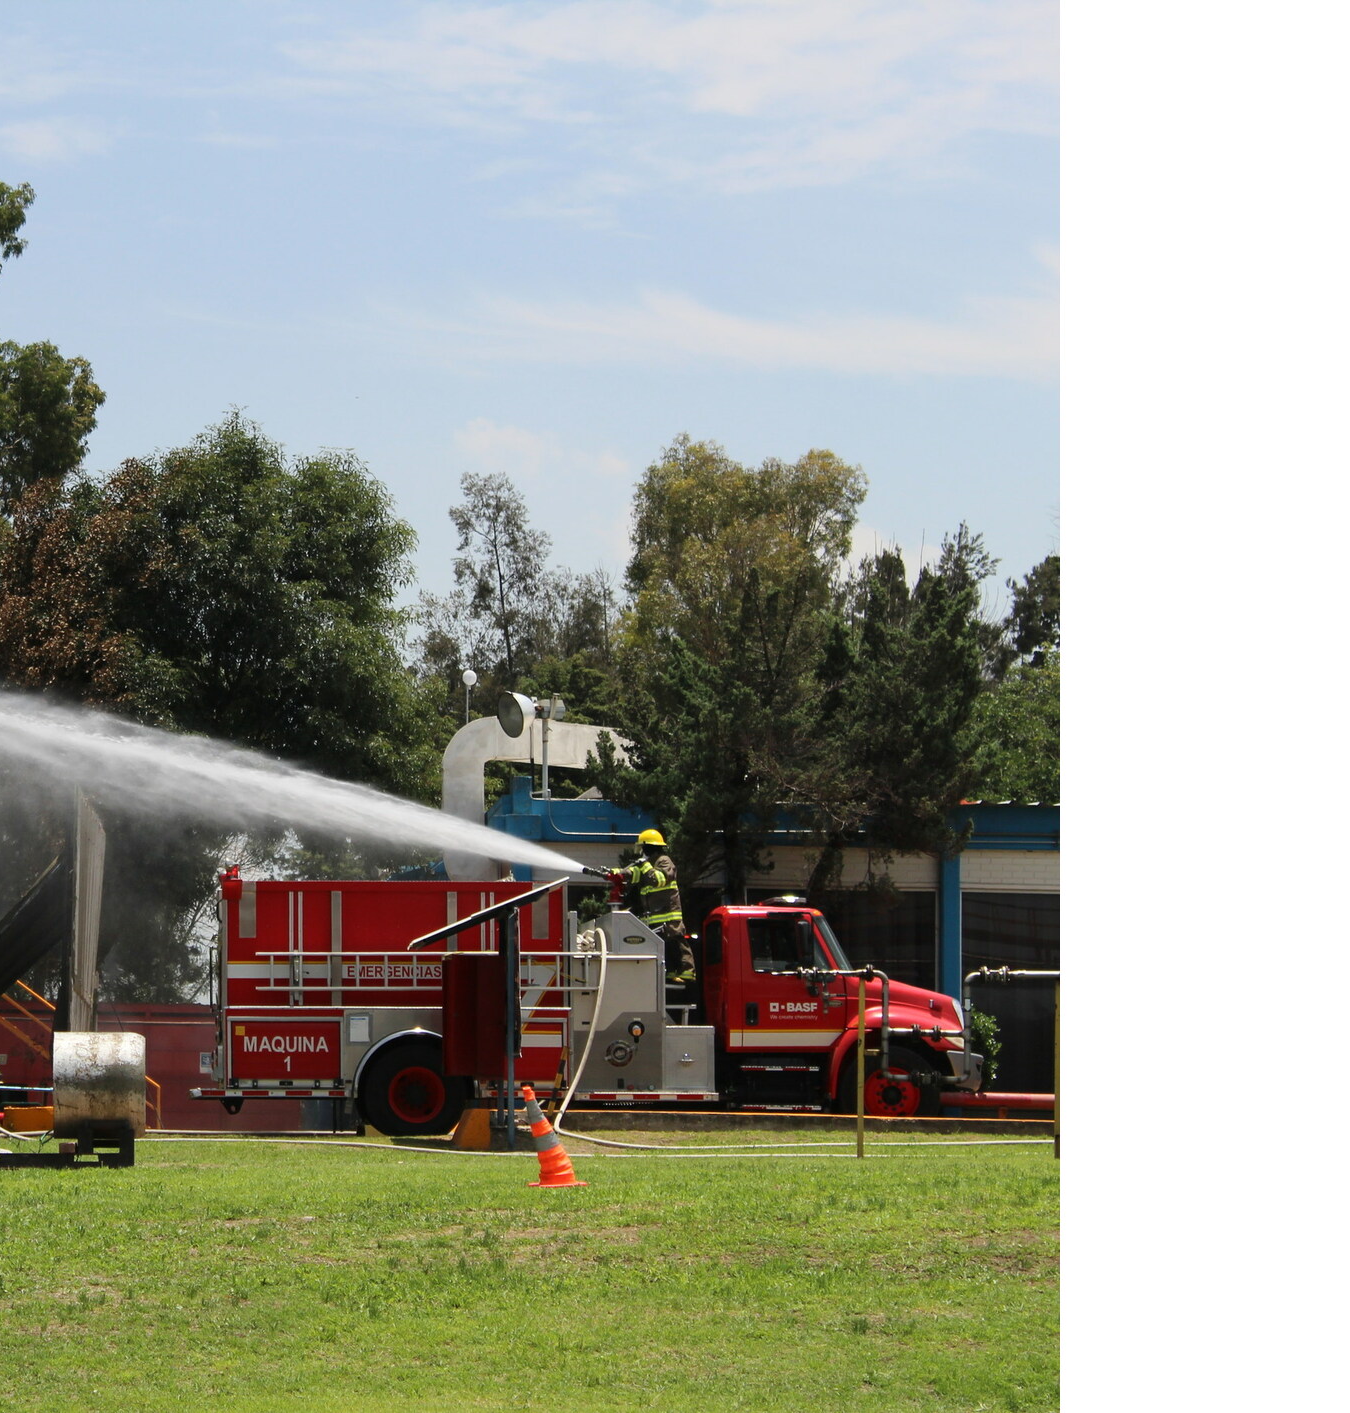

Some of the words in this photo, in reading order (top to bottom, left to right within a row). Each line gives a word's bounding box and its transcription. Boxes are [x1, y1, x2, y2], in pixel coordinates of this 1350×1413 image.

[347, 966, 442, 978] EMERGENCIAS
[786, 1002, 818, 1012] BASF
[243, 1036, 329, 1053] MAQUINA
[283, 1056, 291, 1072] 1
